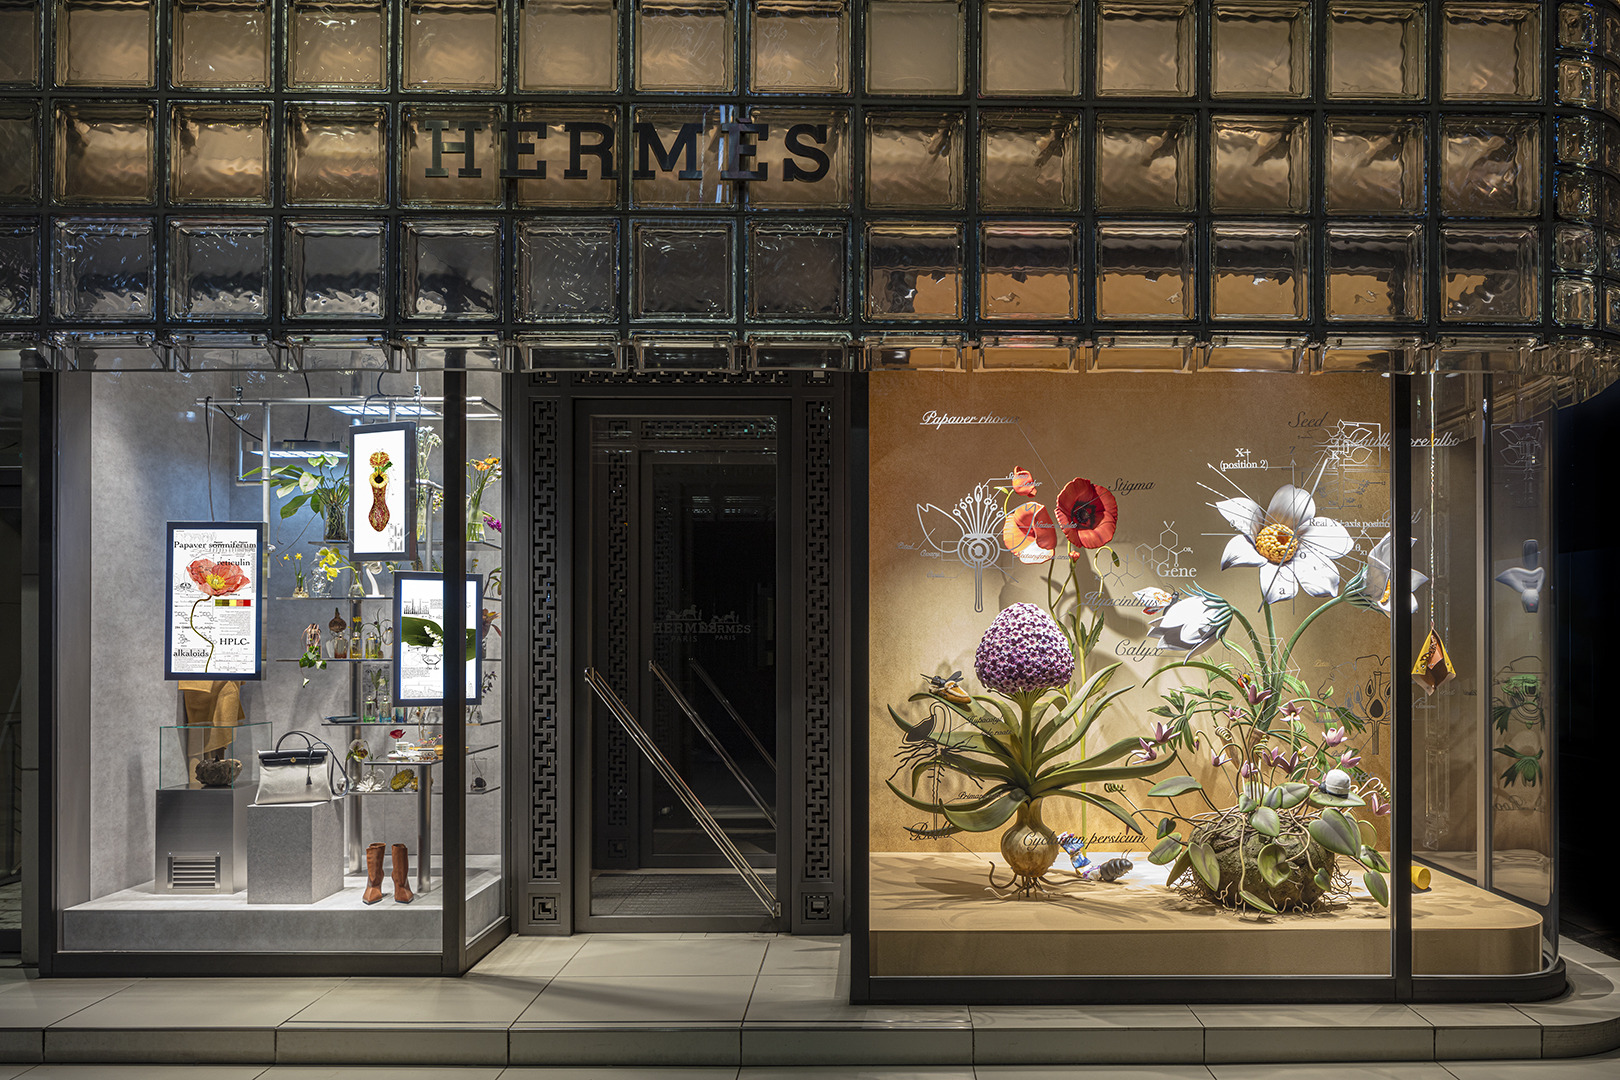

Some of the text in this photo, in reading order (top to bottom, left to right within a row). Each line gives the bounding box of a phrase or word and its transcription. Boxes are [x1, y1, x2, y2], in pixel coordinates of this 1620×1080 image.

[922, 410, 1022, 430] Papaver rhoeas
[1288, 411, 1328, 428] Seed
[1433, 431, 1460, 447] albo
[1220, 460, 1269, 472] (position 2)
[1108, 478, 1156, 496] Stigma
[1309, 518, 1327, 527] Real
[1362, 519, 1390, 530] positio
[174, 540, 256, 550] Papaver somniferum
[1082, 591, 1159, 611] Hyacinthus
[173, 649, 209, 657] alkaloids
[1115, 639, 1164, 662] Calyx
[909, 821, 952, 841] Bulb
[1085, 832, 1148, 850] persicum
